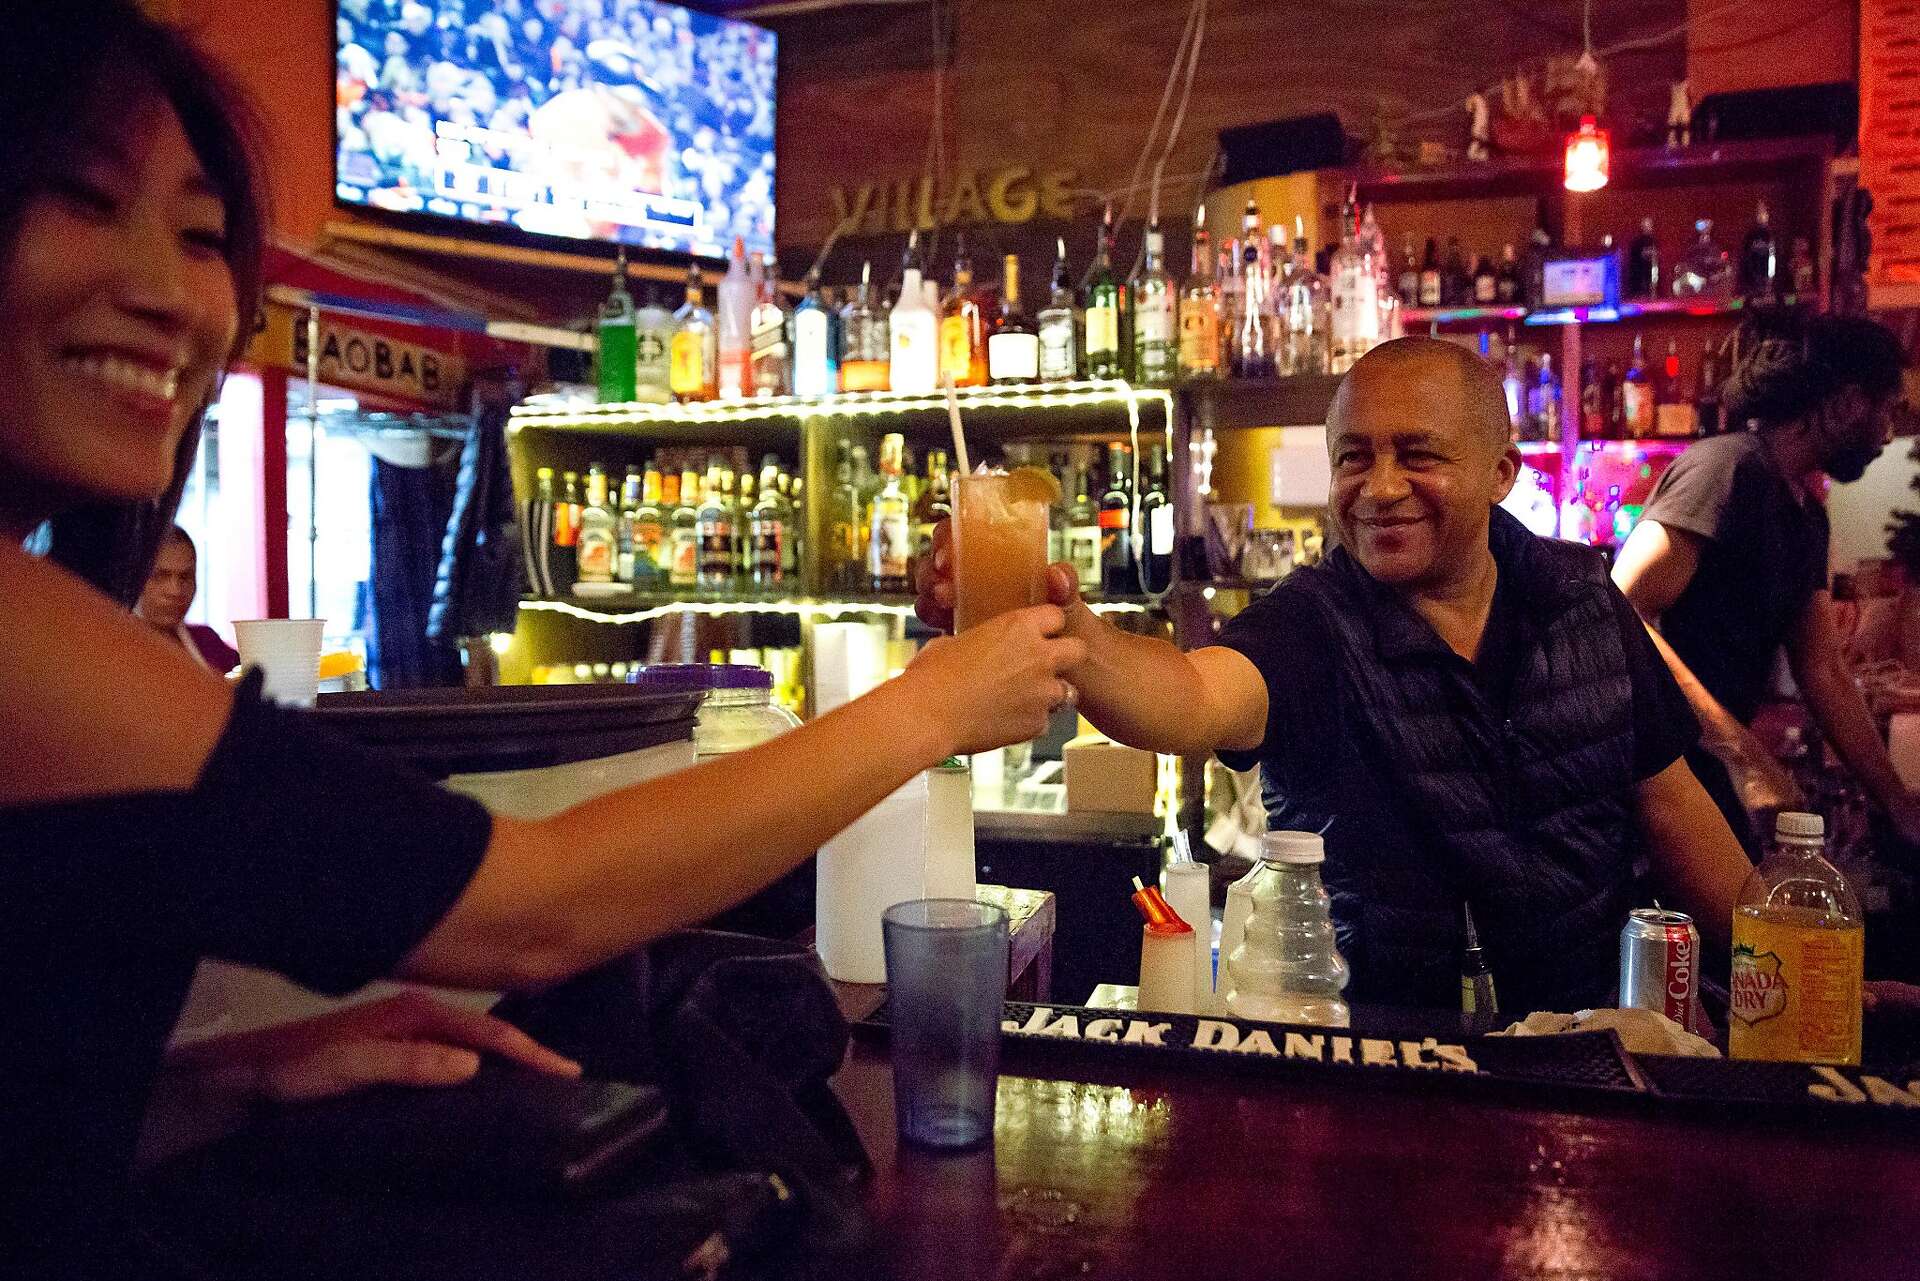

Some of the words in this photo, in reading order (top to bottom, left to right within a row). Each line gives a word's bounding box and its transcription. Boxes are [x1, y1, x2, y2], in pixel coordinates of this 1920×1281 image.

[829, 166, 1077, 236] VILLAGE
[293, 314, 437, 390] BAOBAB
[1668, 940, 1691, 1000] Coke
[1734, 990, 1767, 1009] DRY
[1001, 1006, 1172, 1047] JACK
[1189, 1019, 1479, 1074] DANIEL'S
